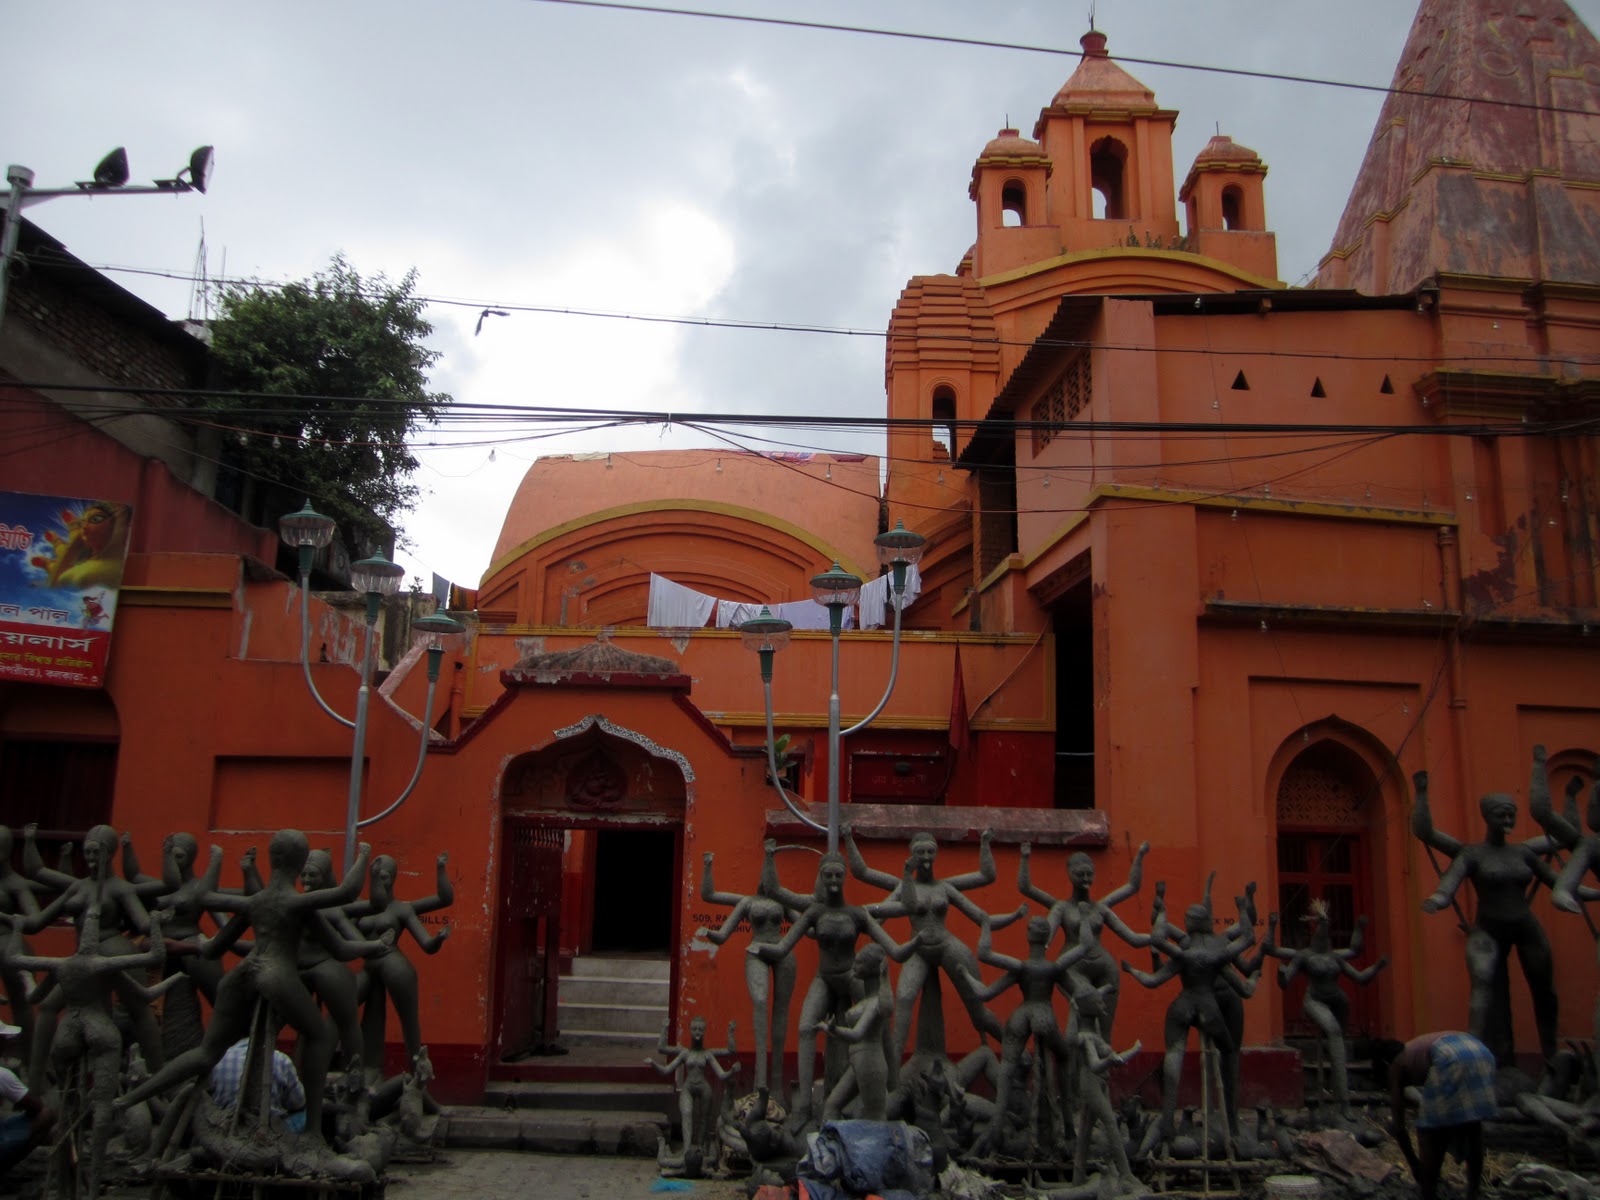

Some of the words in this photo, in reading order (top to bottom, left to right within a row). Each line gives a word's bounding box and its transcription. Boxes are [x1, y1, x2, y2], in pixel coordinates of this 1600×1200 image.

[28, 606, 70, 622] পাল
[419, 915, 449, 925] BILLS
[1224, 917, 1235, 926] NO
